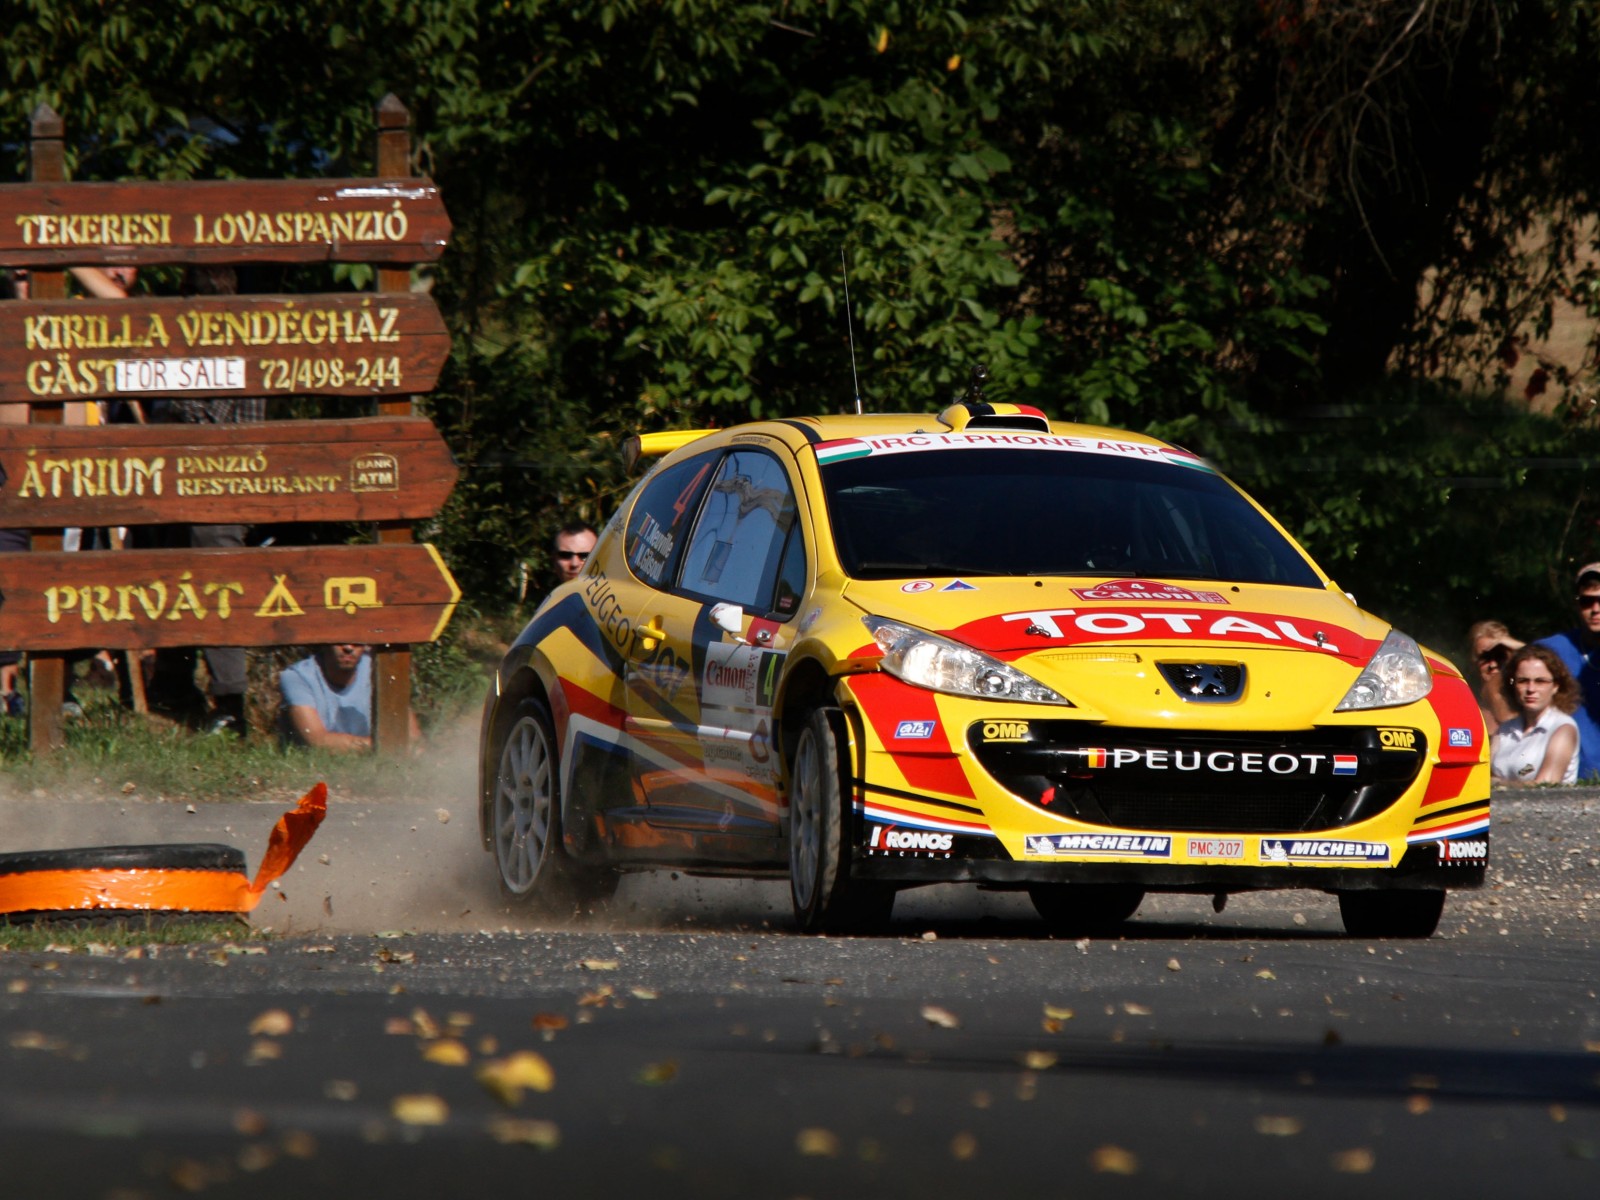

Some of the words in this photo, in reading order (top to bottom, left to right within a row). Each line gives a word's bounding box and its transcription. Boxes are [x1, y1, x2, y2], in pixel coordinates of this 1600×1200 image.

[16, 214, 171, 245] TEKERESI
[193, 200, 408, 244] LOVASPANZIÓ
[24, 313, 170, 349] KIRILLA
[176, 299, 400, 347] VENDÉGHÁZ
[122, 360, 165, 389] FOR
[177, 359, 239, 387] SALE
[260, 357, 402, 391] 72/498-244
[870, 435, 932, 450] IRC
[939, 434, 1087, 449] I-PHONE
[1096, 440, 1158, 456] APP
[18, 446, 165, 498] ÁTRIUM
[176, 450, 268, 474] PANZIÓ
[355, 458, 393, 470] BANK
[176, 475, 342, 497] RESTAURANT
[356, 470, 394, 486] ATM
[44, 571, 244, 623] PRIVÁT
[1082, 590, 1193, 600] Canon
[1002, 609, 1340, 653] TOTAL
[705, 659, 747, 689] Canon
[763, 653, 778, 706] 4
[982, 723, 1029, 739] OMP
[1379, 729, 1416, 748] OMP
[1113, 748, 1325, 775] PEUGEOT
[869, 823, 954, 850] KRONOS
[1059, 836, 1169, 852] MICHELIN
[1436, 837, 1488, 860] KRONOS
[869, 849, 951, 859] RACING
[1290, 841, 1387, 857] MICHELIN
